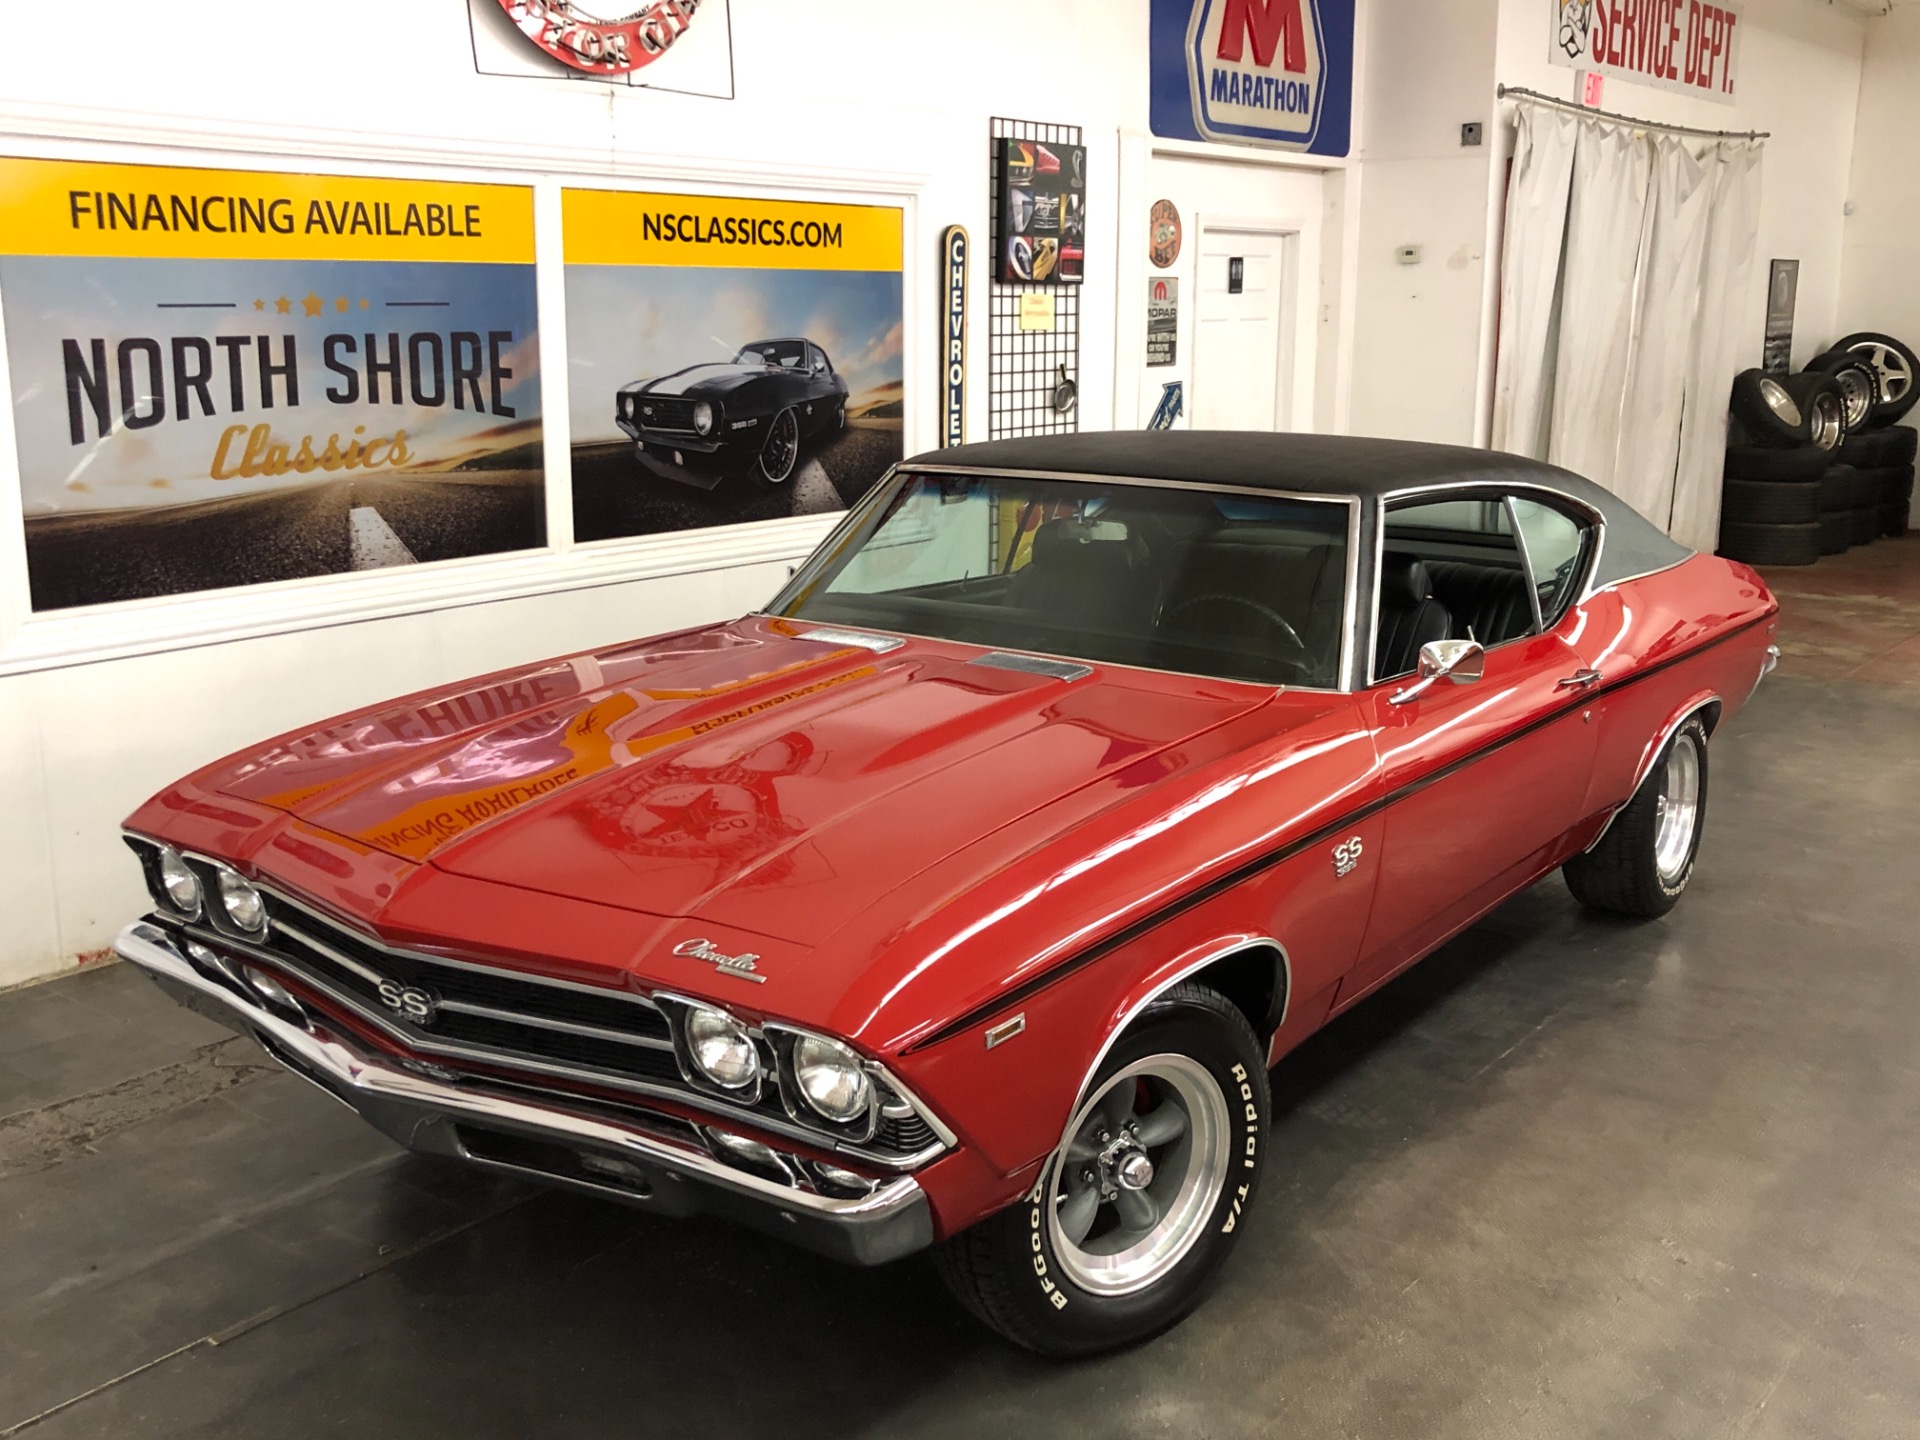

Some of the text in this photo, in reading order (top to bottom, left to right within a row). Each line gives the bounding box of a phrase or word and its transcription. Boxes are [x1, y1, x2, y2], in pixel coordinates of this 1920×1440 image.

[1216, 0, 1307, 74] M
[1592, 0, 1737, 95] SERVICE DEPT.
[1211, 68, 1310, 115] MARATHON
[69, 191, 482, 237] FINANCING AVAILABLE
[643, 212, 842, 248] NSCLASSICS.COM
[62, 331, 516, 446] NORTH SHORE
[210, 423, 414, 480] Classics
[1333, 836, 1363, 867] SS
[672, 938, 760, 971] Chevelle
[378, 980, 430, 1016] SS
[1221, 1063, 1258, 1233] Radial T/A
